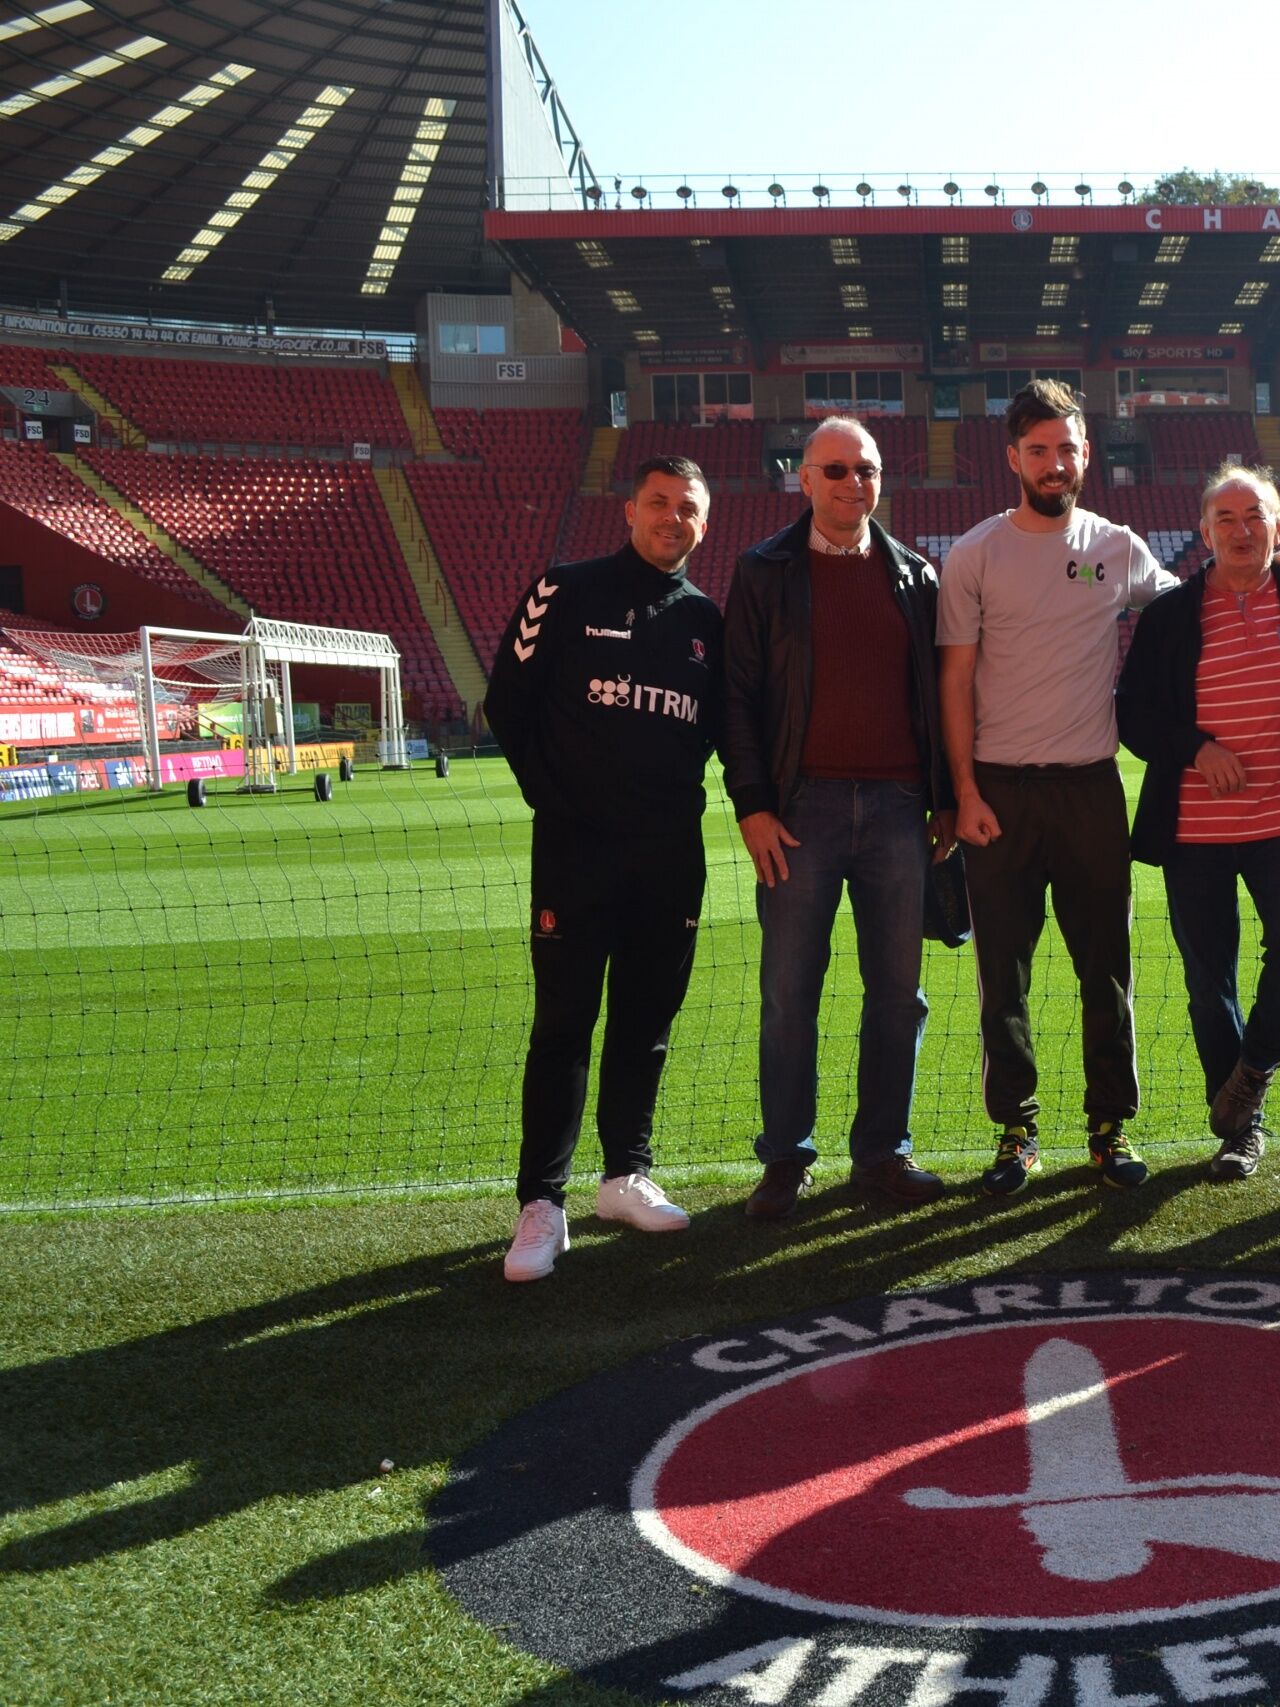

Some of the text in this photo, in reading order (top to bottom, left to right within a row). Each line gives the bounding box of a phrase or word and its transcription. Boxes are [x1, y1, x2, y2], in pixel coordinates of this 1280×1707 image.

[5, 314, 67, 334] INFORMATION
[68, 323, 90, 335] CALL
[176, 331, 190, 343] OR
[191, 332, 220, 345] EMAIL
[359, 341, 384, 355] FSB
[1122, 346, 1223, 360] sky SPORTS HD
[499, 364, 523, 378] FSE
[24, 389, 50, 406] 24
[1066, 560, 1105, 589] C4C
[585, 625, 632, 639] hummel
[634, 684, 698, 724] ITRM
